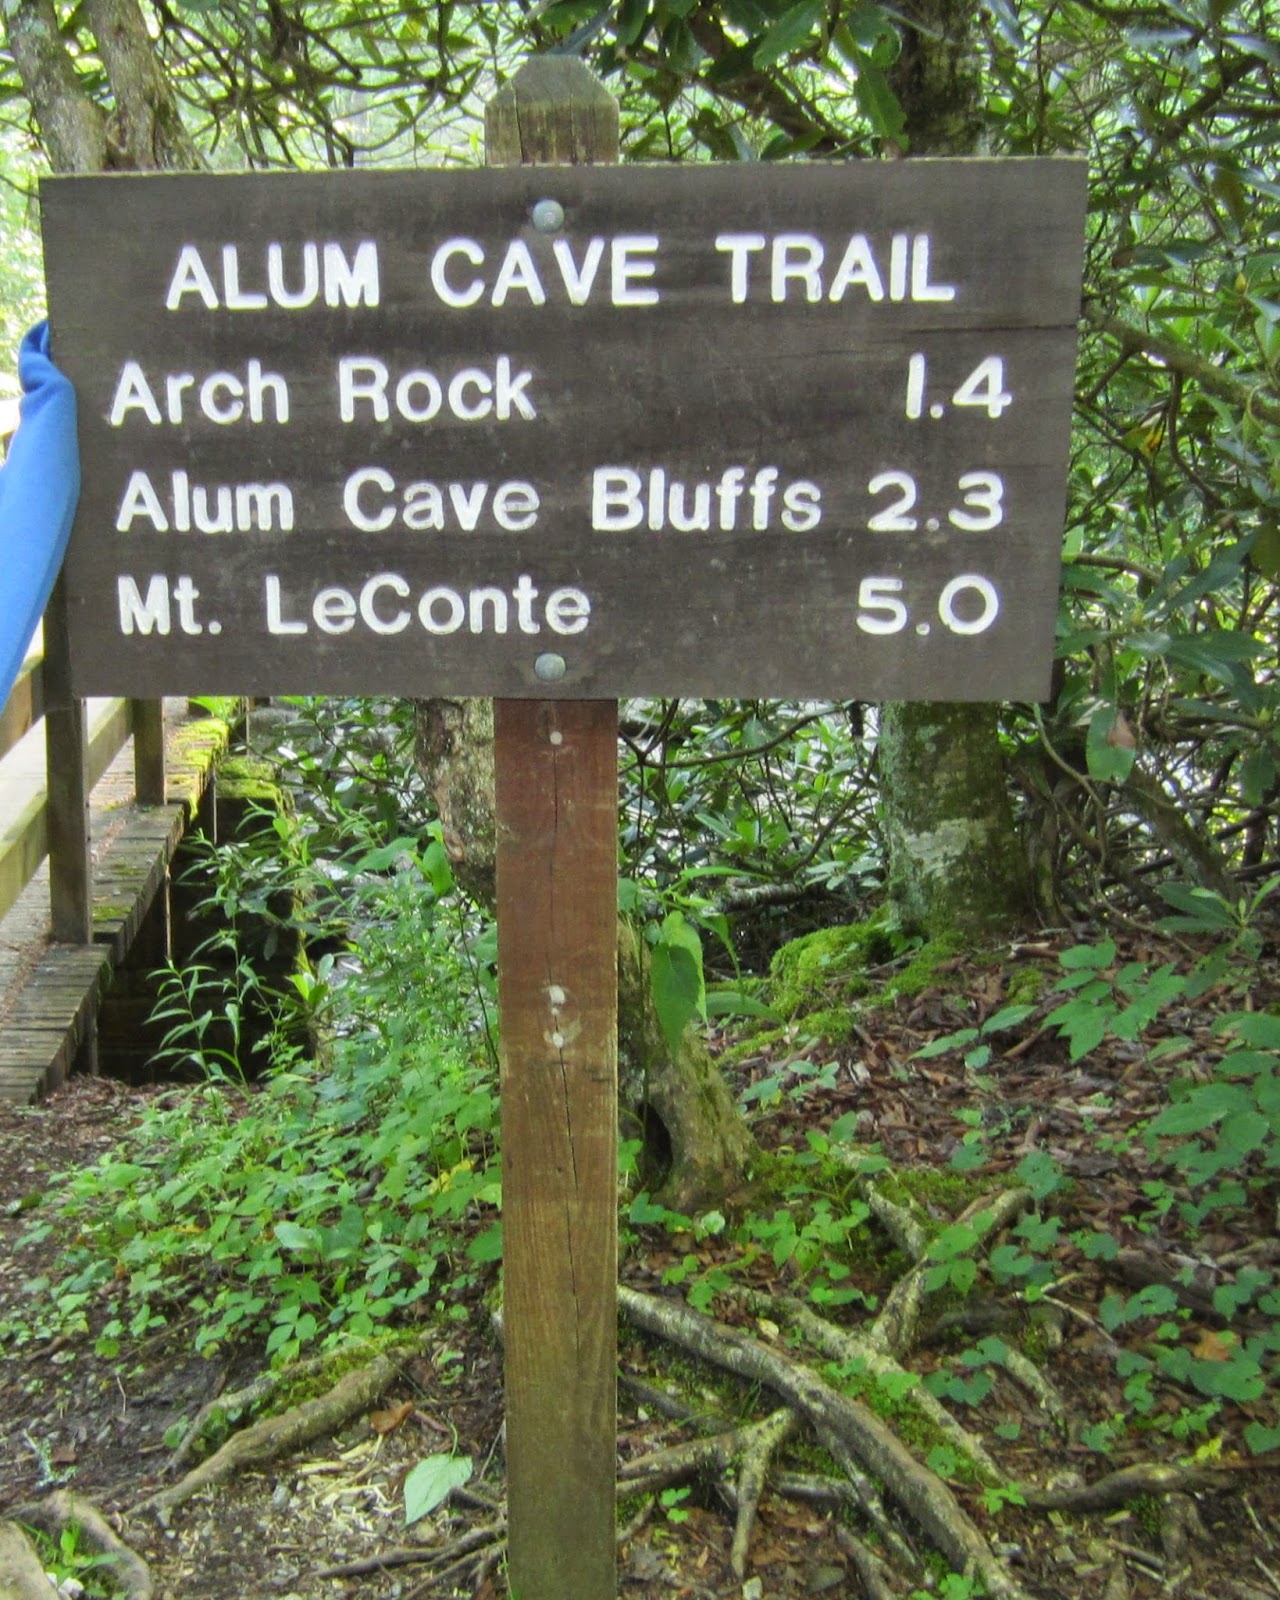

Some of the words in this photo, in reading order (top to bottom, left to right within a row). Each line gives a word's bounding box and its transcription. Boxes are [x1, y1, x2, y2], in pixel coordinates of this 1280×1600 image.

[165, 243, 380, 310] ALUM
[430, 236, 660, 307] CAVE
[714, 233, 956, 303] TRAIL
[109, 359, 290, 426] Arch
[337, 355, 537, 423] Rock
[906, 353, 1013, 419] 1.4
[115, 470, 295, 534] Alum
[341, 467, 540, 532] Cave
[591, 467, 822, 532] Bluffs
[867, 470, 1004, 532] 2.3
[117, 574, 222, 635] Mt.
[265, 572, 591, 635] LeConte
[856, 574, 1000, 636] 5.0
